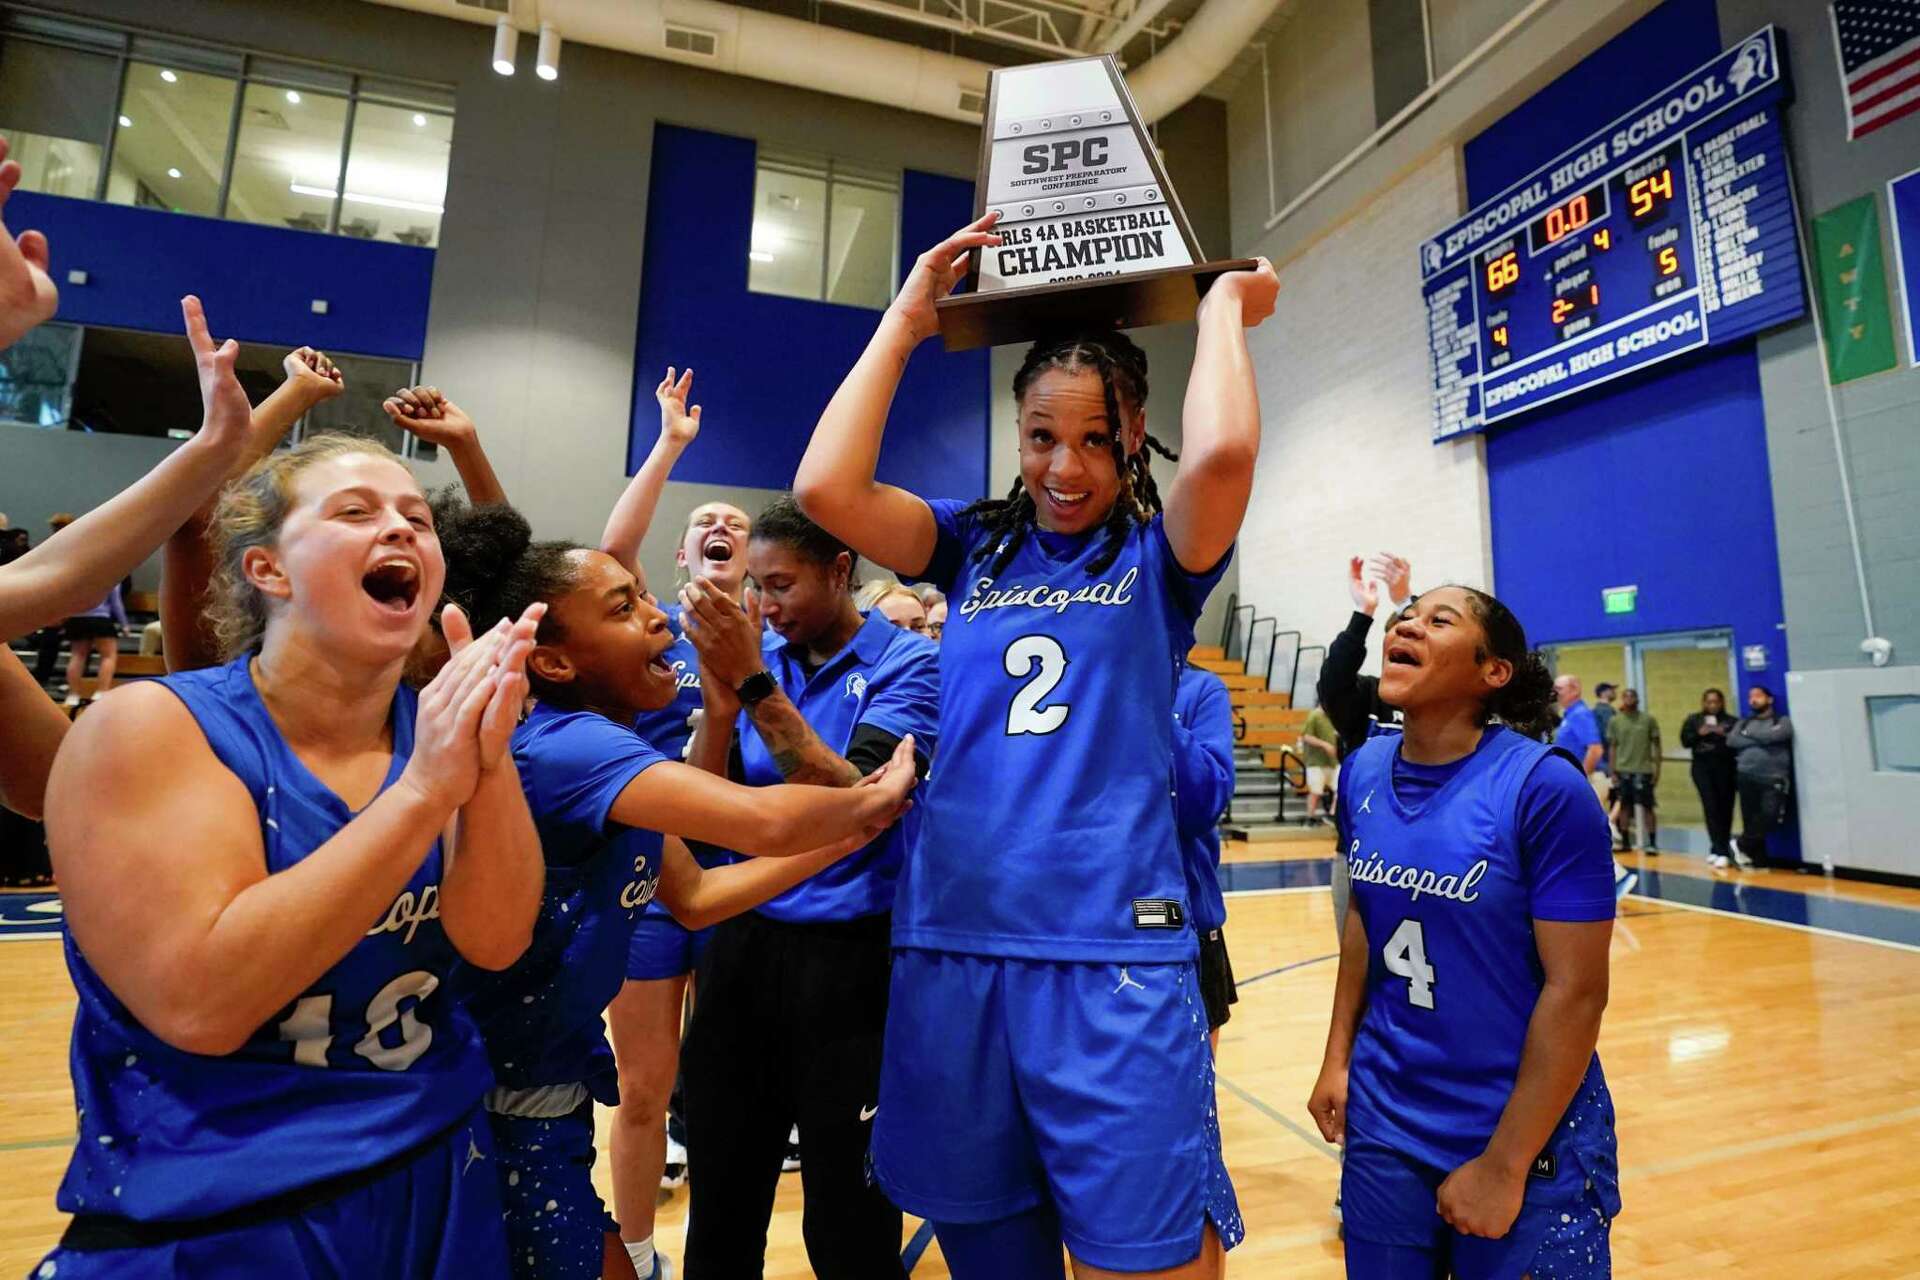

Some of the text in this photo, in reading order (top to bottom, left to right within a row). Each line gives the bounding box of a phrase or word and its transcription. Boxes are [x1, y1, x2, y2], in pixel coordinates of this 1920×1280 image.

[1023, 137, 1108, 175] SPC
[1444, 75, 1726, 257] EPISCOPAL HIGH SCHOOL
[1010, 167, 1127, 188] SOUTHWEST PREPARATORY
[1041, 178, 1099, 191] CONFERENCE
[1631, 169, 1673, 217] 54
[989, 210, 1171, 247] RLS 4A BASKETBALL
[1546, 195, 1588, 242] 0.0
[998, 230, 1165, 277] CHAMPION
[1594, 229, 1609, 249] 4
[1488, 252, 1519, 291] 66
[1660, 247, 1678, 275] 5
[1493, 326, 1508, 347] 4
[1485, 310, 1700, 408] EPISCOPAL HIGH SCHOOL
[960, 566, 1138, 623] Episcopal
[1004, 634, 1070, 736] 2
[1383, 919, 1435, 1010] 4
[1538, 1159, 1549, 1171] M
